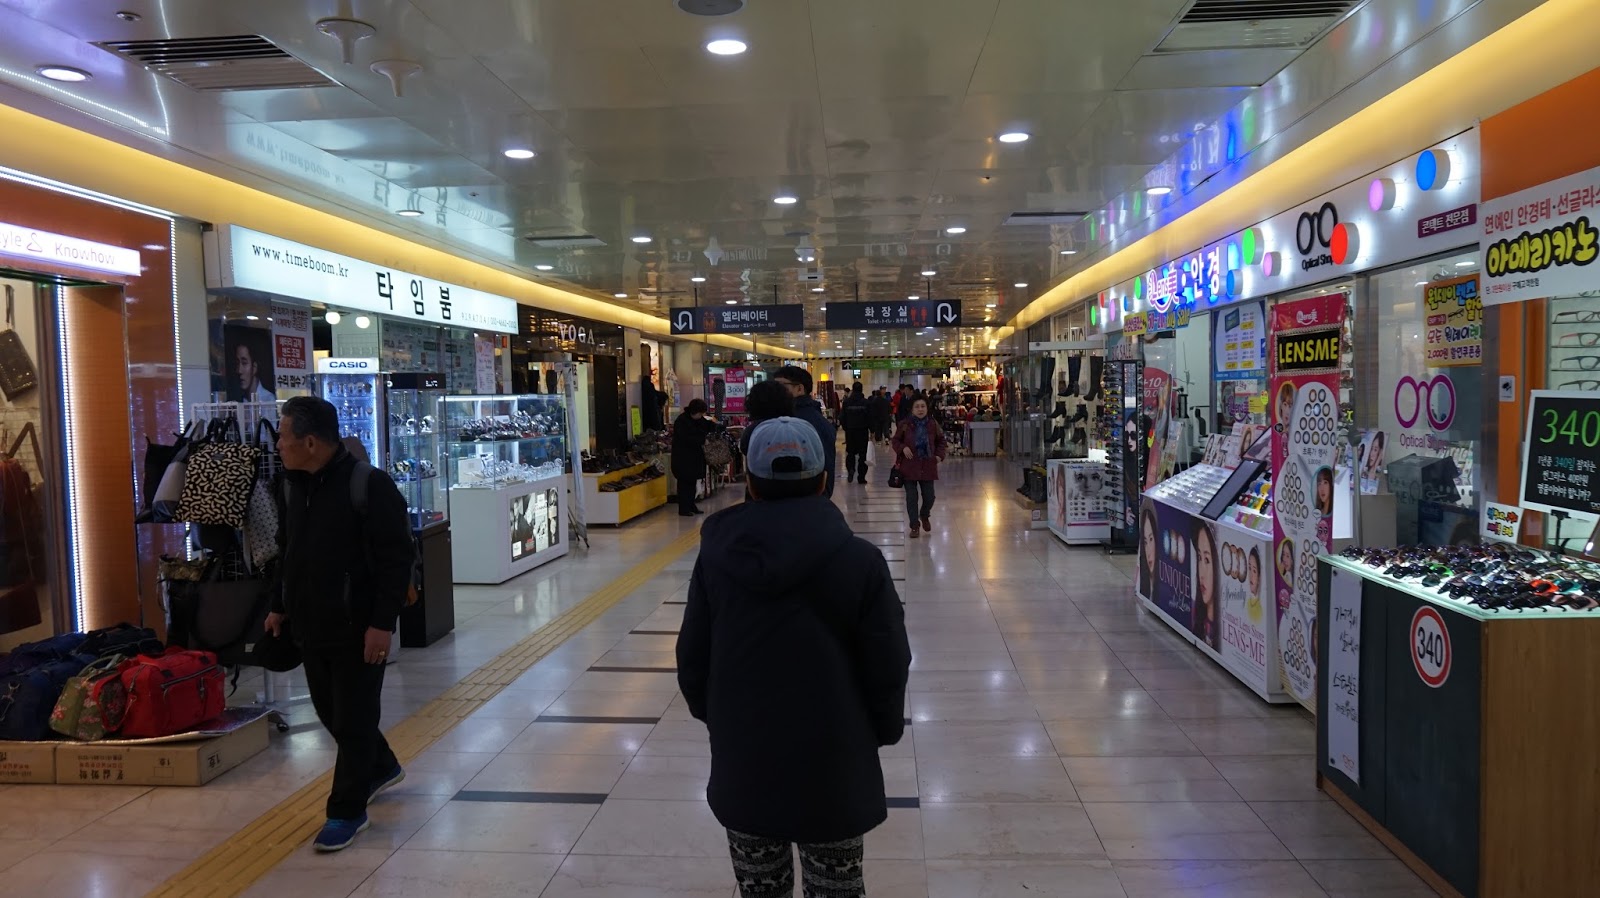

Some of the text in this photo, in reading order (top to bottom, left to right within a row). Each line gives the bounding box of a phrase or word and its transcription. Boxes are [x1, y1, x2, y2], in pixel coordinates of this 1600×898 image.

[1445, 208, 1469, 228] 전문점
[1485, 208, 1514, 235] 연예인
[0, 231, 115, 265] yle Knowhow
[252, 243, 349, 278] www.timeboom.kr
[1486, 216, 1599, 278] 아메리카노
[1191, 246, 1220, 299] 안경
[1302, 258, 1320, 272] Optical
[722, 310, 768, 322] 엘리베이터
[864, 305, 908, 318] 화장실
[1279, 337, 1339, 364] LENSME
[1400, 433, 1425, 449] Optical
[1539, 408, 1600, 447] 340
[1159, 560, 1191, 599] UNIQUE
[1222, 620, 1265, 667] LENS-ME
[1417, 626, 1444, 668] 340
